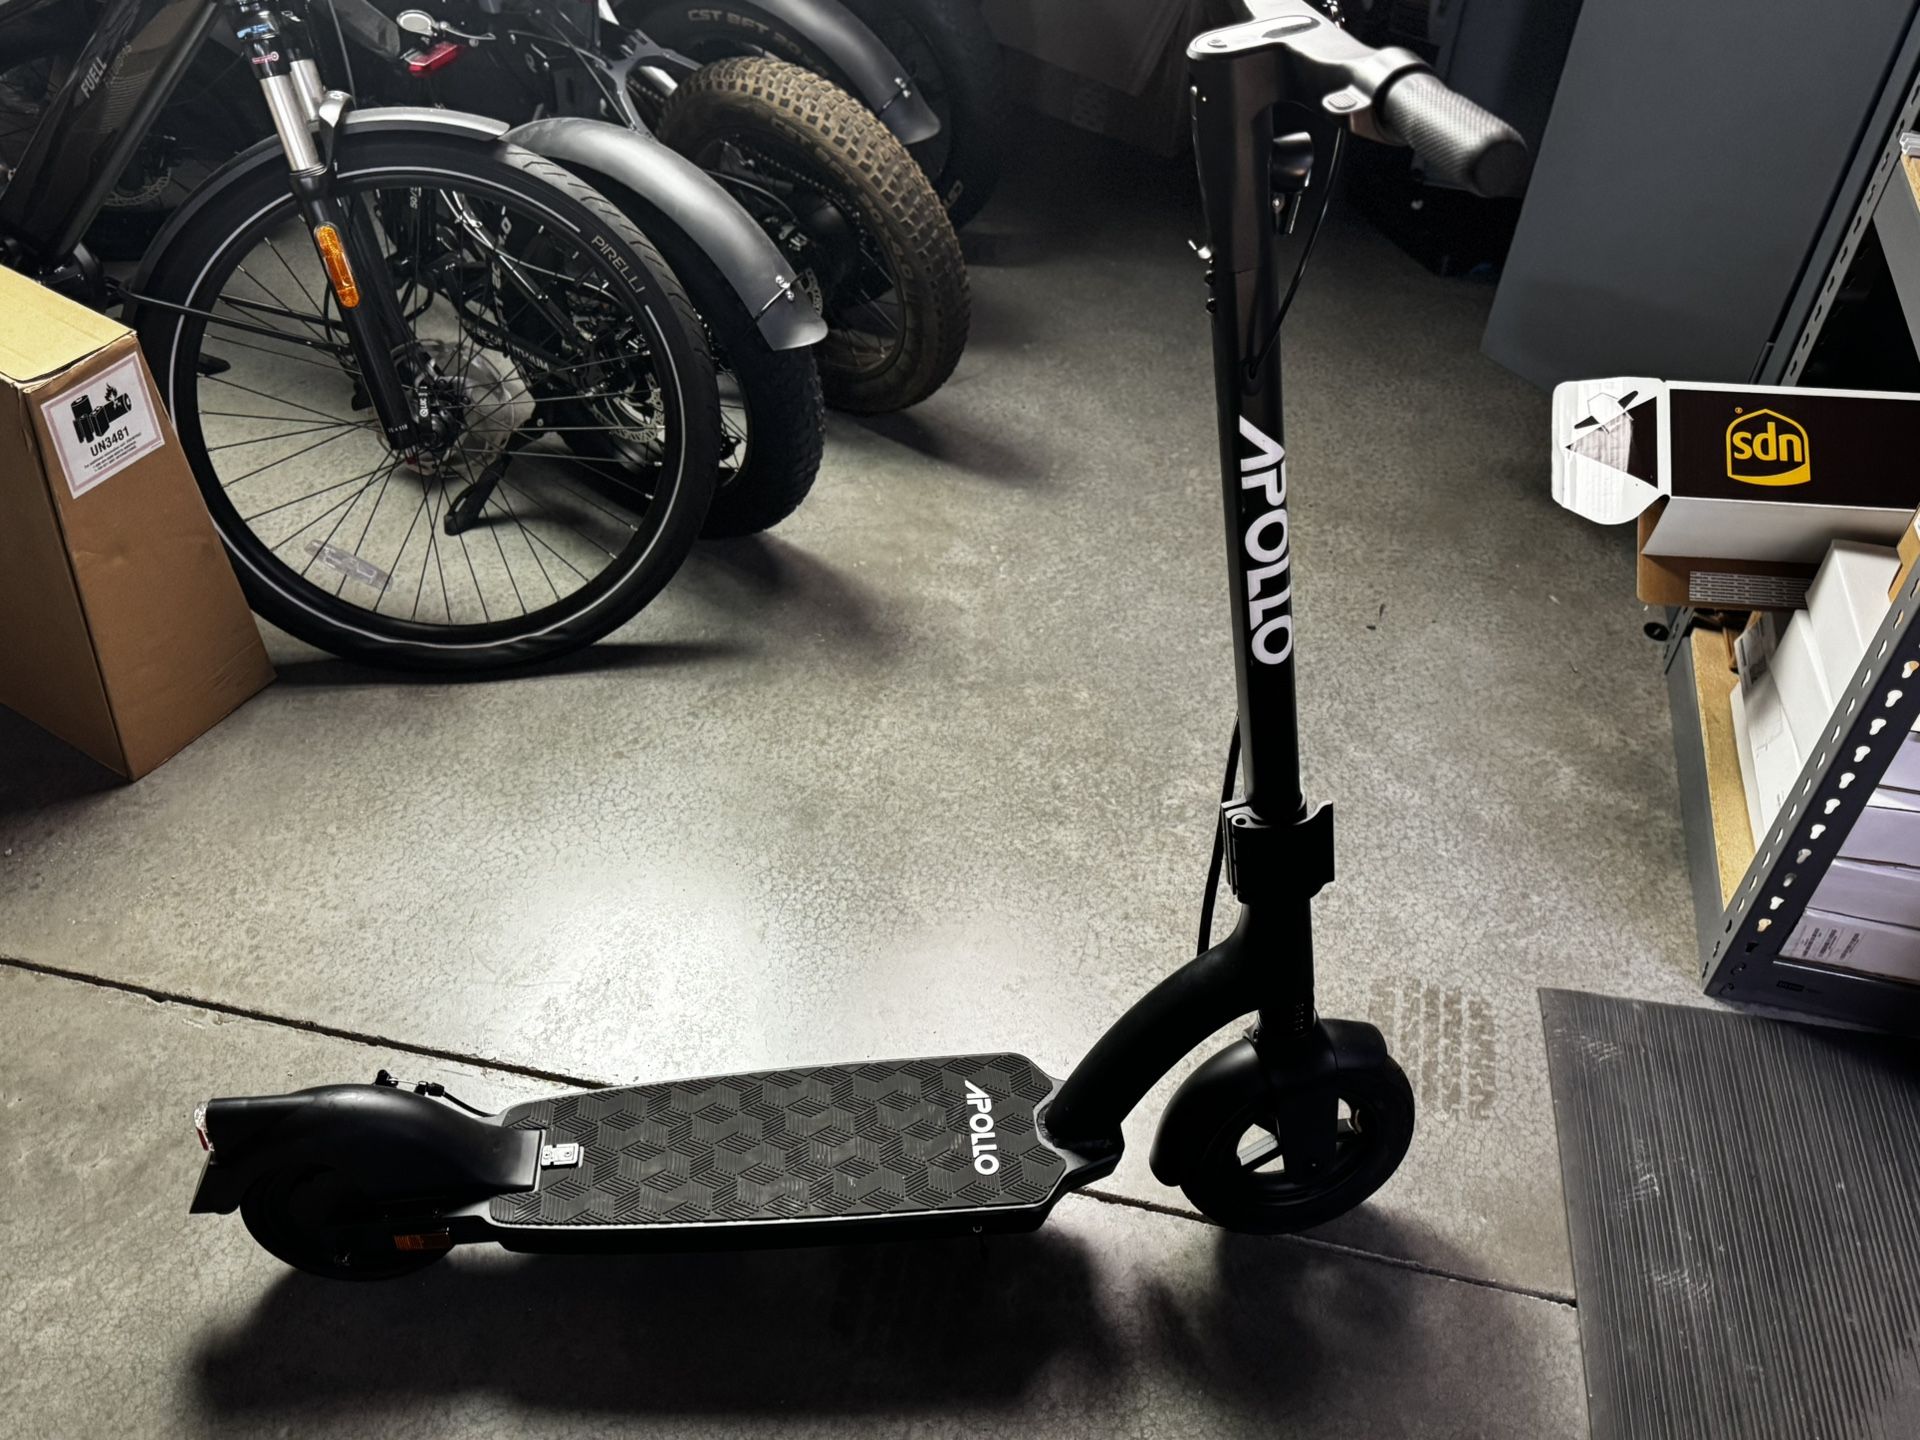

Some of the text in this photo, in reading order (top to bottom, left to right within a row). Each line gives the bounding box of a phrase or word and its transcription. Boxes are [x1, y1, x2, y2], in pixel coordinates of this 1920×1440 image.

[687, 9, 722, 21] CST
[80, 56, 108, 99] FUELL
[591, 234, 646, 294] PIRELLI
[90, 426, 130, 457] UN3481
[1732, 421, 1803, 463] ups
[1238, 414, 1294, 666] APOLLO
[964, 1079, 1000, 1176] APOLLO
